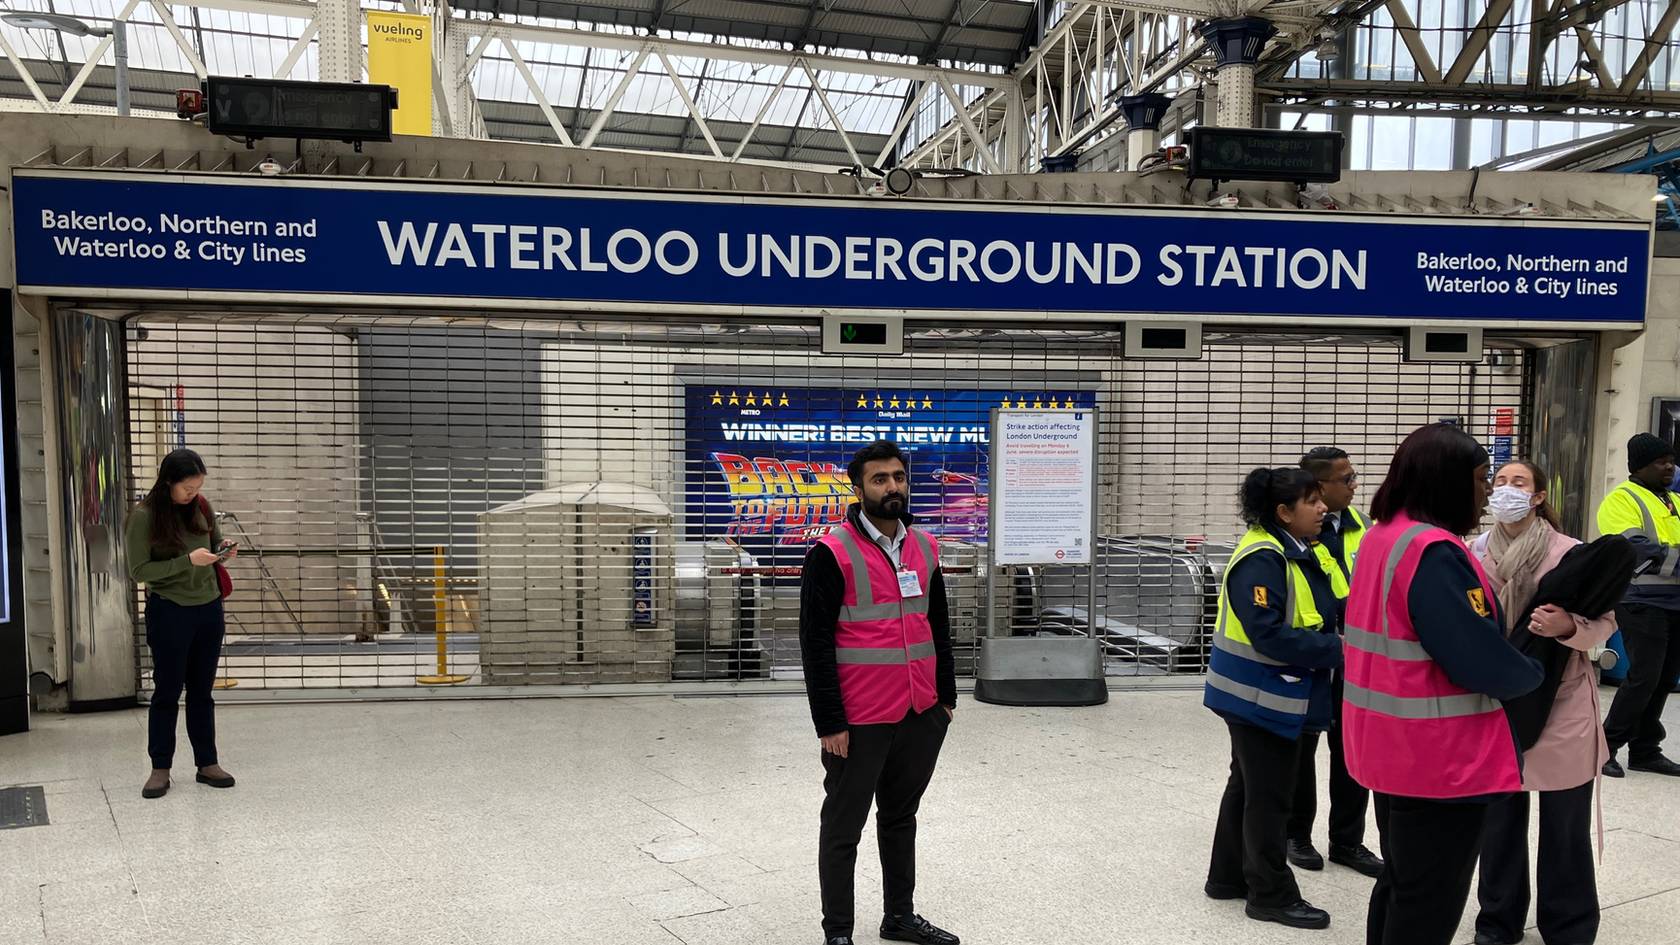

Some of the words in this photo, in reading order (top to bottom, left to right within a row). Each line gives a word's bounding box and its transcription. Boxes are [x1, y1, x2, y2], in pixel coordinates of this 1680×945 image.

[373, 21, 424, 41] vueling
[1247, 138, 1313, 151] Emergency
[1263, 156, 1282, 168] not
[41, 209, 153, 234] Bakerloo,
[160, 213, 267, 236] Northern
[275, 218, 317, 238] and
[53, 236, 167, 259] Waterloo
[173, 240, 191, 260] &
[198, 240, 246, 266] City
[252, 242, 306, 263] lines
[377, 220, 699, 275] WATERLOO
[718, 232, 1141, 285] UNDERGROUND
[1157, 244, 1367, 290] STATION
[1416, 252, 1502, 272] Bakerloo,
[1506, 254, 1590, 272] Northern
[1595, 257, 1628, 273] and
[1425, 275, 1510, 294] Waterloo
[1515, 276, 1529, 294] &
[1534, 277, 1571, 299] City
[1576, 278, 1618, 296] lines
[878, 411, 896, 419] Daily
[720, 422, 826, 441] WINNER!
[829, 425, 891, 442] BEST
[896, 426, 954, 443] NEW
[1050, 423, 1080, 431] affecting
